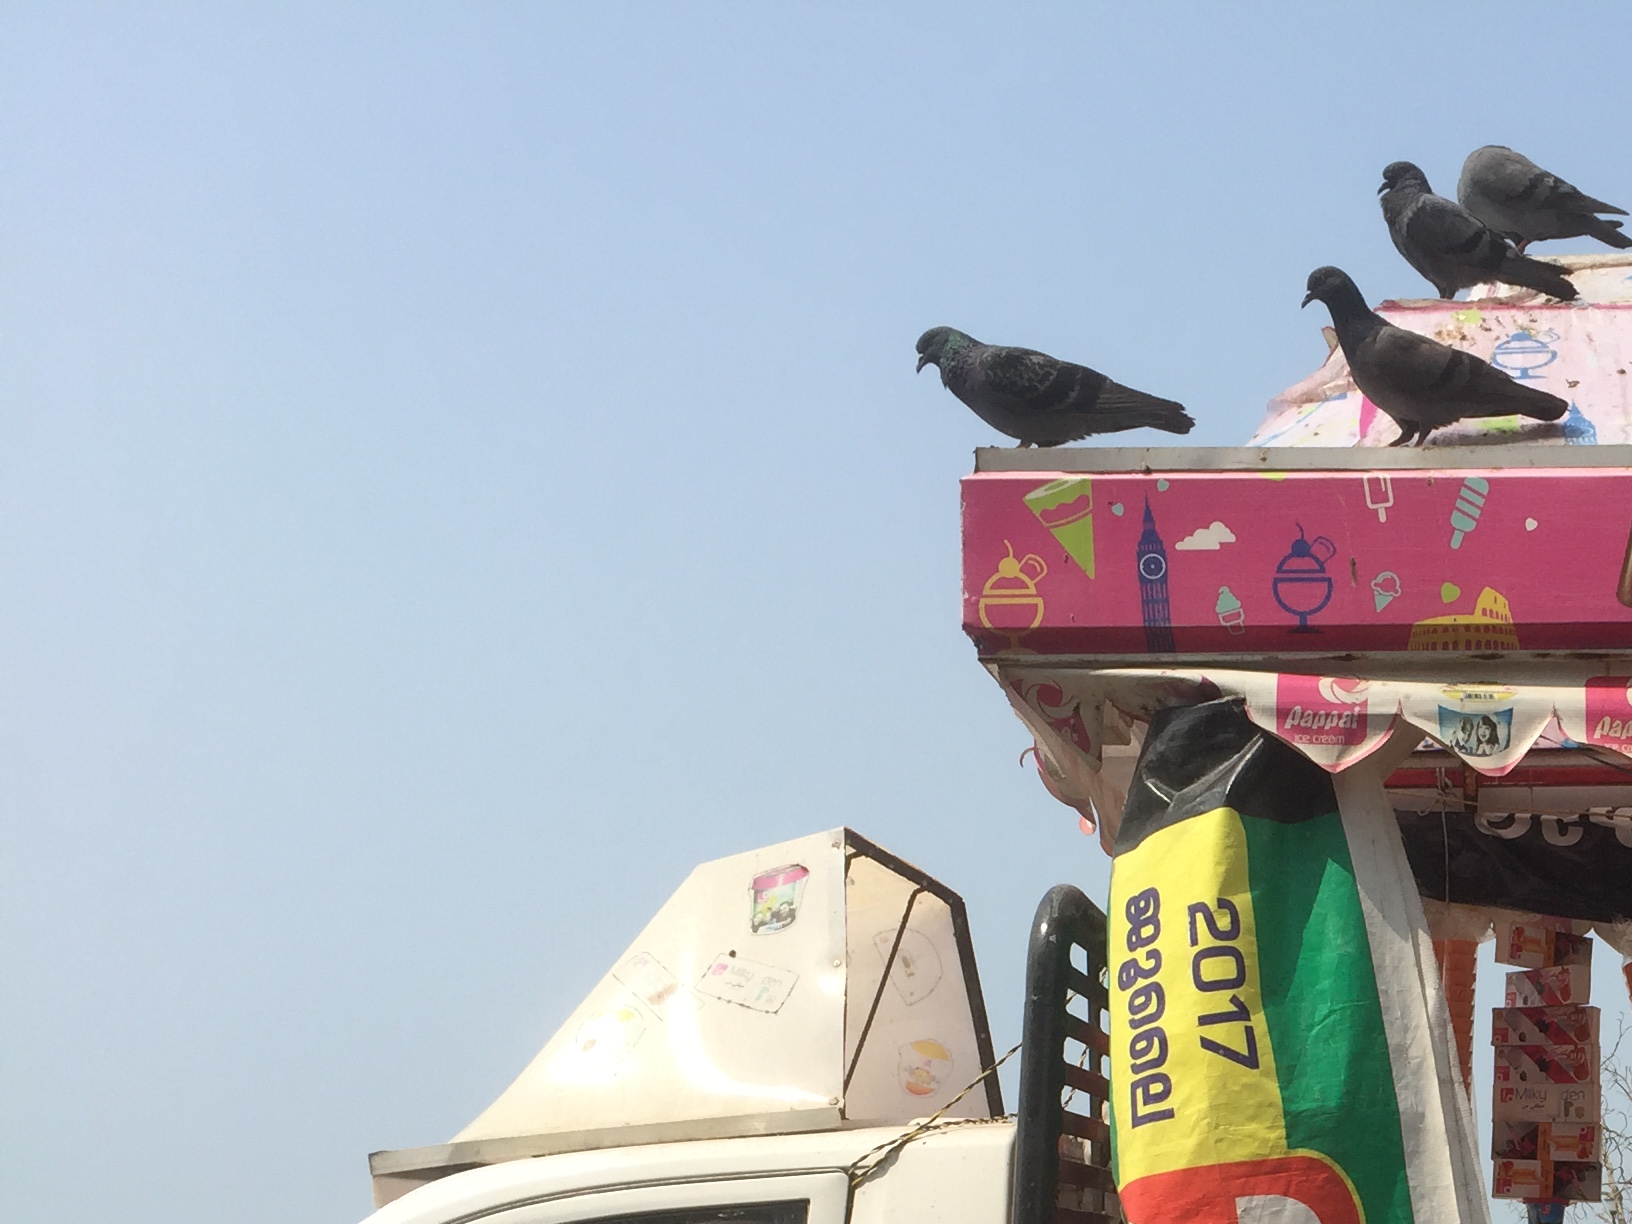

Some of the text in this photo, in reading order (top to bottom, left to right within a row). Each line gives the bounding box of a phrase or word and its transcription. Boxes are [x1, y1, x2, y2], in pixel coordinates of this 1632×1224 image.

[1312, 734, 1345, 745] cream
[1117, 886, 1175, 1129] ജൂലൈ
[1187, 897, 1260, 1070] 2017
